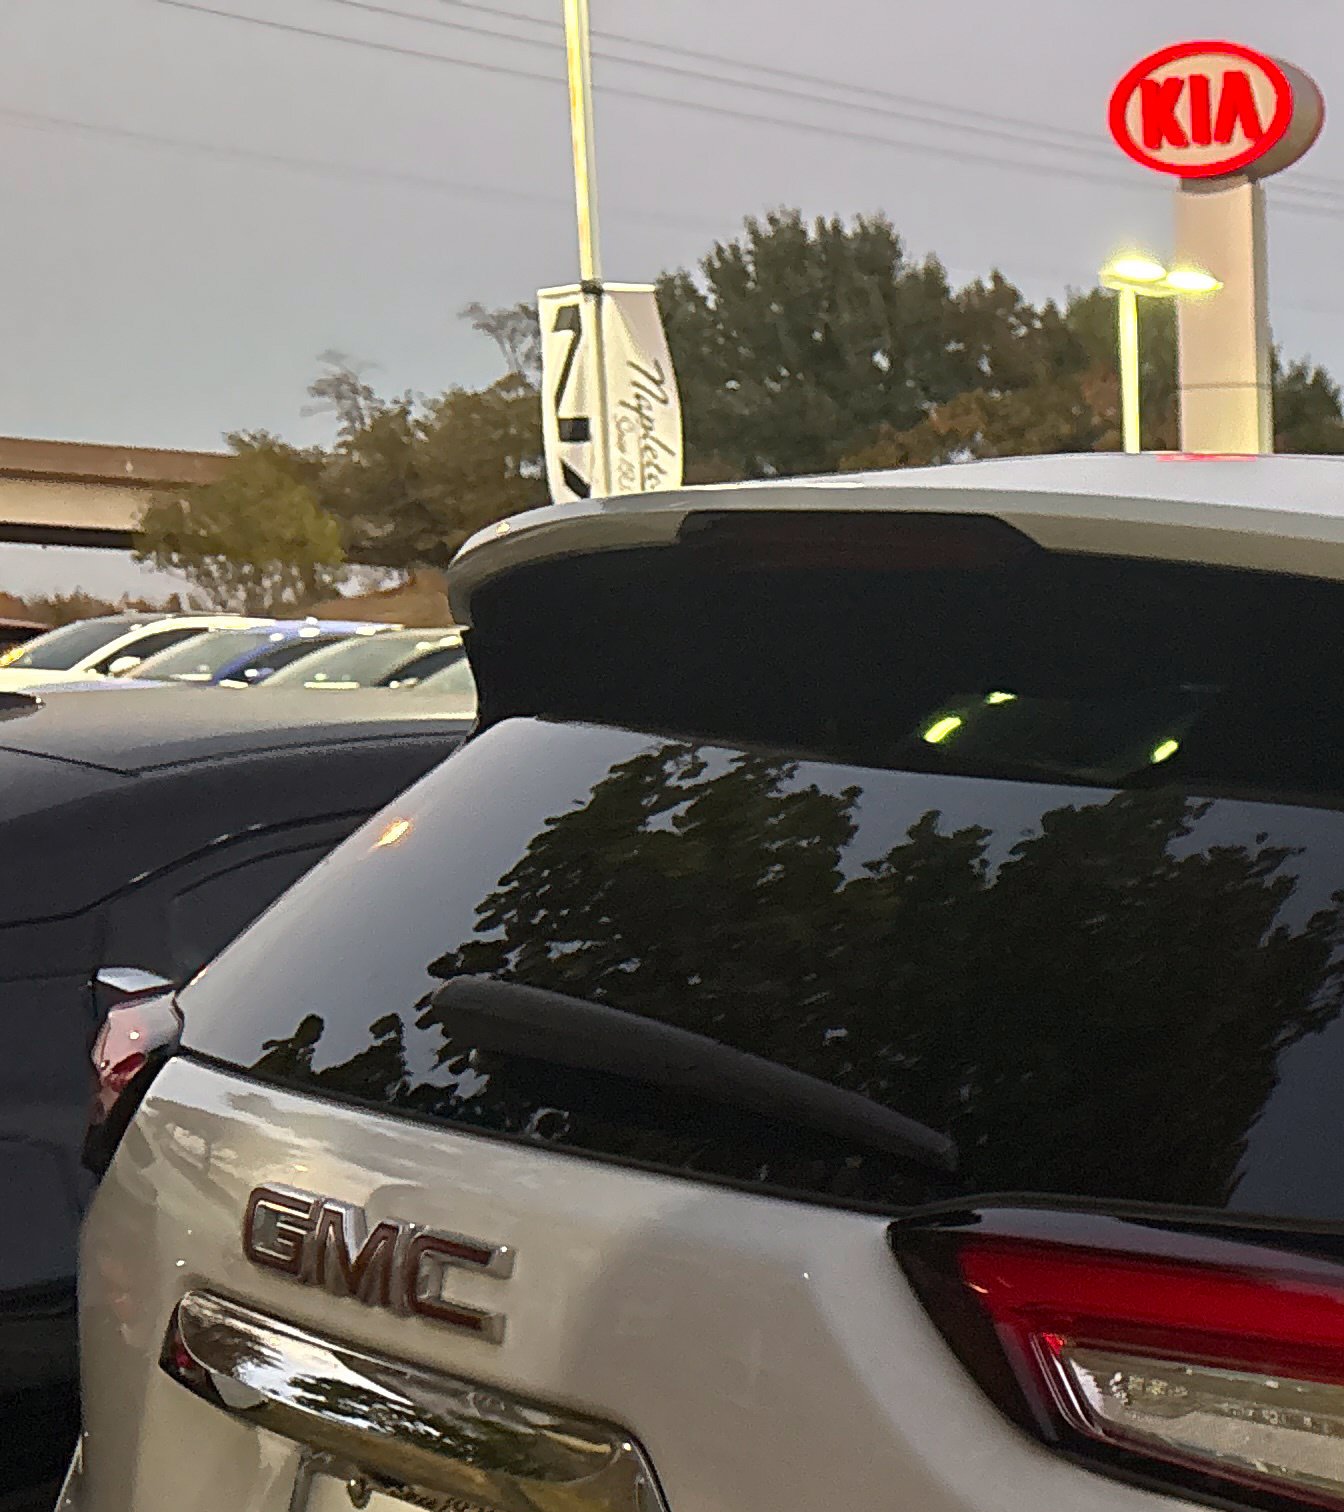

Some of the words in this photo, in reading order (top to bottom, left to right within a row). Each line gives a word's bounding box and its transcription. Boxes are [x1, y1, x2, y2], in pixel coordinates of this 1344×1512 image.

[1140, 70, 1264, 150] KIA
[619, 359, 676, 491] Napleto
[242, 1182, 516, 1346] GMC
